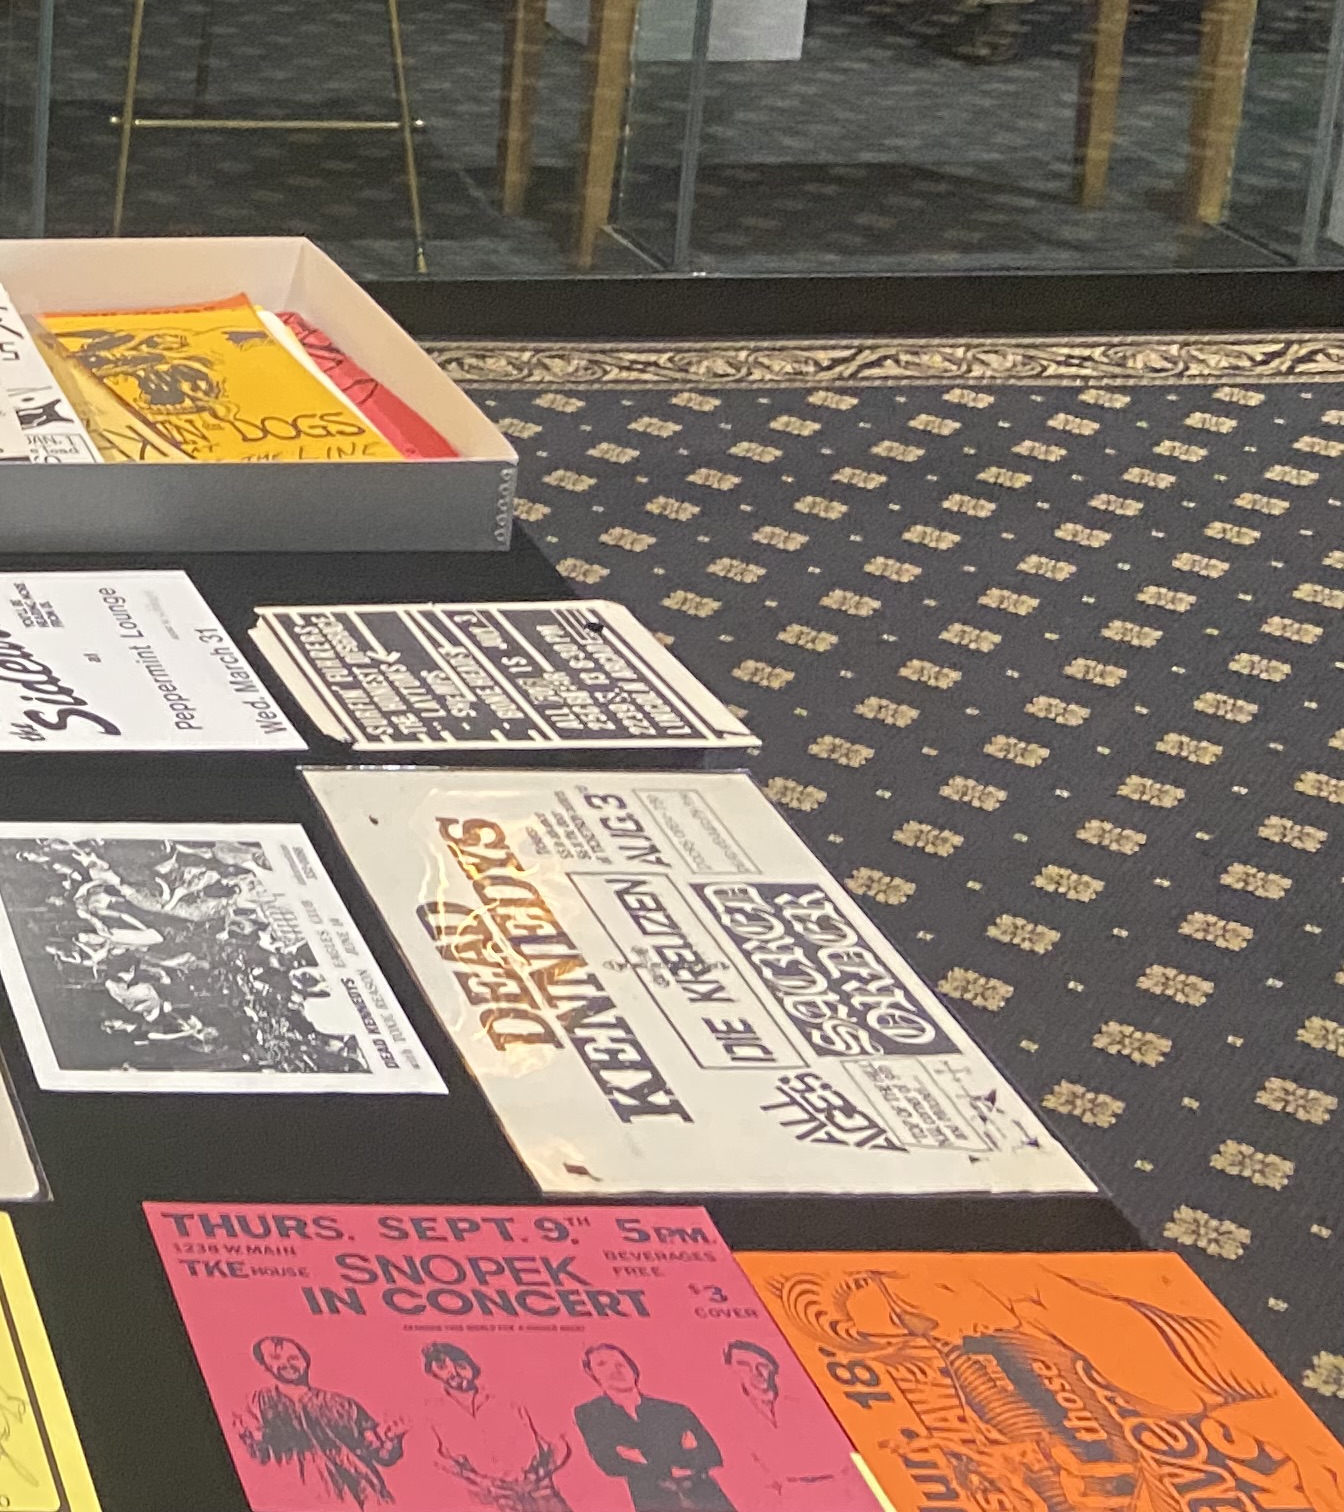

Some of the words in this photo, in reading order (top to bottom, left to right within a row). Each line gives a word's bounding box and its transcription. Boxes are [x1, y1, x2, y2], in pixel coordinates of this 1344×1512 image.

[89, 587, 149, 637] Lounge
[192, 628, 227, 643] 31
[81, 652, 103, 662] at
[205, 647, 262, 692] March
[124, 644, 209, 729] Peppermint
[3, 722, 46, 741] the
[238, 696, 290, 733] Wed.
[601, 878, 736, 1002] KREUZEN
[404, 899, 569, 1051] DEAD
[423, 816, 702, 1123] KENNEDYS
[339, 977, 381, 1034] KENNEDYS
[370, 1038, 400, 1069] DEAD
[700, 1017, 780, 1062] DIE
[744, 1085, 847, 1145] ALL
[160, 1212, 357, 1242] THURS.
[377, 1215, 530, 1244] SEPT.
[177, 1258, 250, 1278] TKE
[333, 1251, 593, 1289] SNOPEK
[613, 1266, 666, 1277] FREE
[307, 1287, 366, 1317] IN
[381, 1287, 655, 1319] CONCERT
[694, 1307, 760, 1319] COVER
[1032, 1359, 1108, 1440] those
